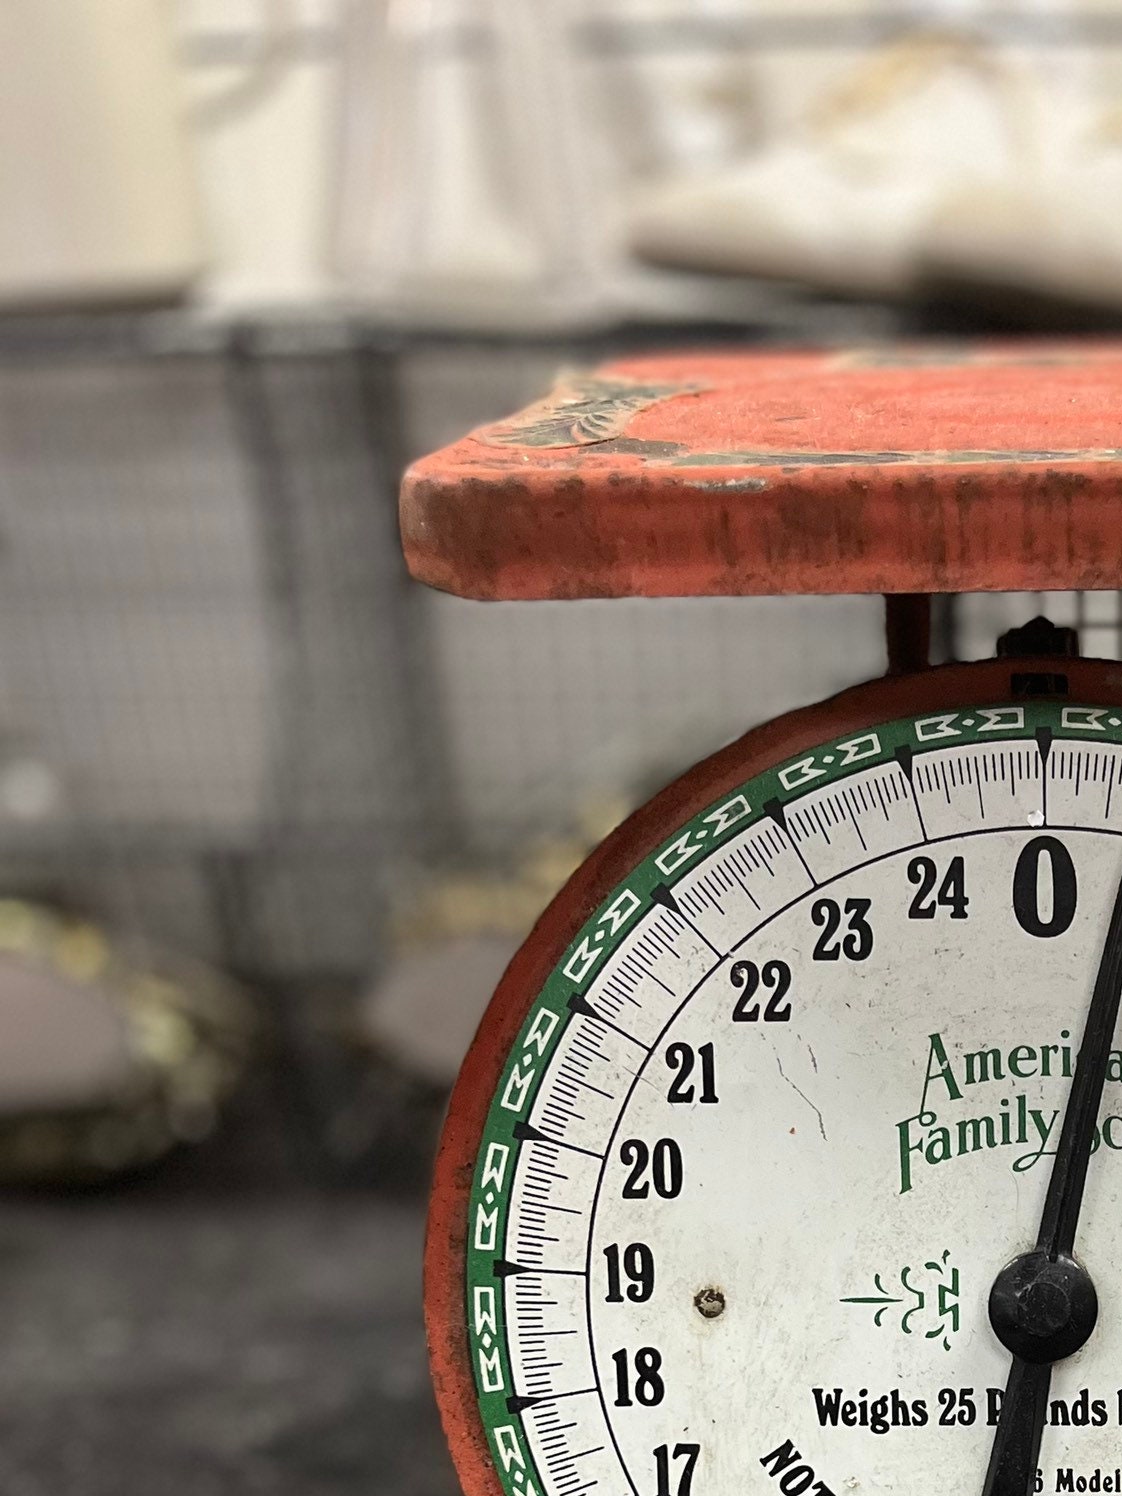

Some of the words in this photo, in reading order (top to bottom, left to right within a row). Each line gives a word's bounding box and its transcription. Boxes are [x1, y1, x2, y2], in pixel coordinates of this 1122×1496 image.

[907, 856, 969, 919] 24
[1012, 836, 1077, 938] 0
[811, 898, 873, 961] 23
[730, 960, 791, 1022] 22
[666, 1042, 718, 1104] 21
[620, 1138, 682, 1200] 20
[896, 1095, 1060, 1195] Family
[603, 1243, 654, 1303] 19
[612, 1347, 664, 1407] 18
[812, 1388, 928, 1434] Weighs
[938, 1388, 976, 1426] 25
[986, 1388, 1108, 1426] Pnds
[1055, 1468, 1121, 1493] Model
